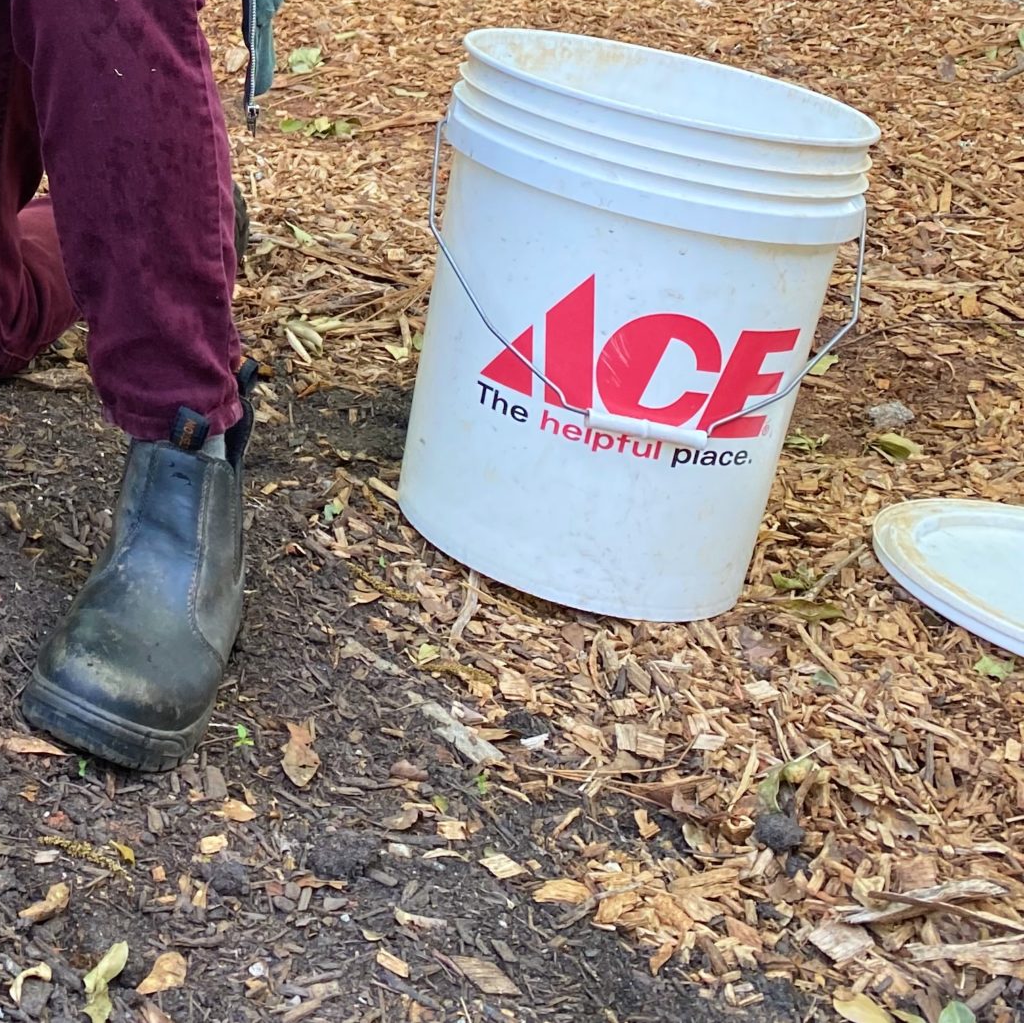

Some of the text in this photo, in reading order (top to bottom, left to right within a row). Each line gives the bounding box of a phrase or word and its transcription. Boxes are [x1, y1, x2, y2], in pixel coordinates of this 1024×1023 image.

[479, 274, 801, 438] ACE
[477, 380, 528, 423] The
[540, 409, 663, 460] helpful
